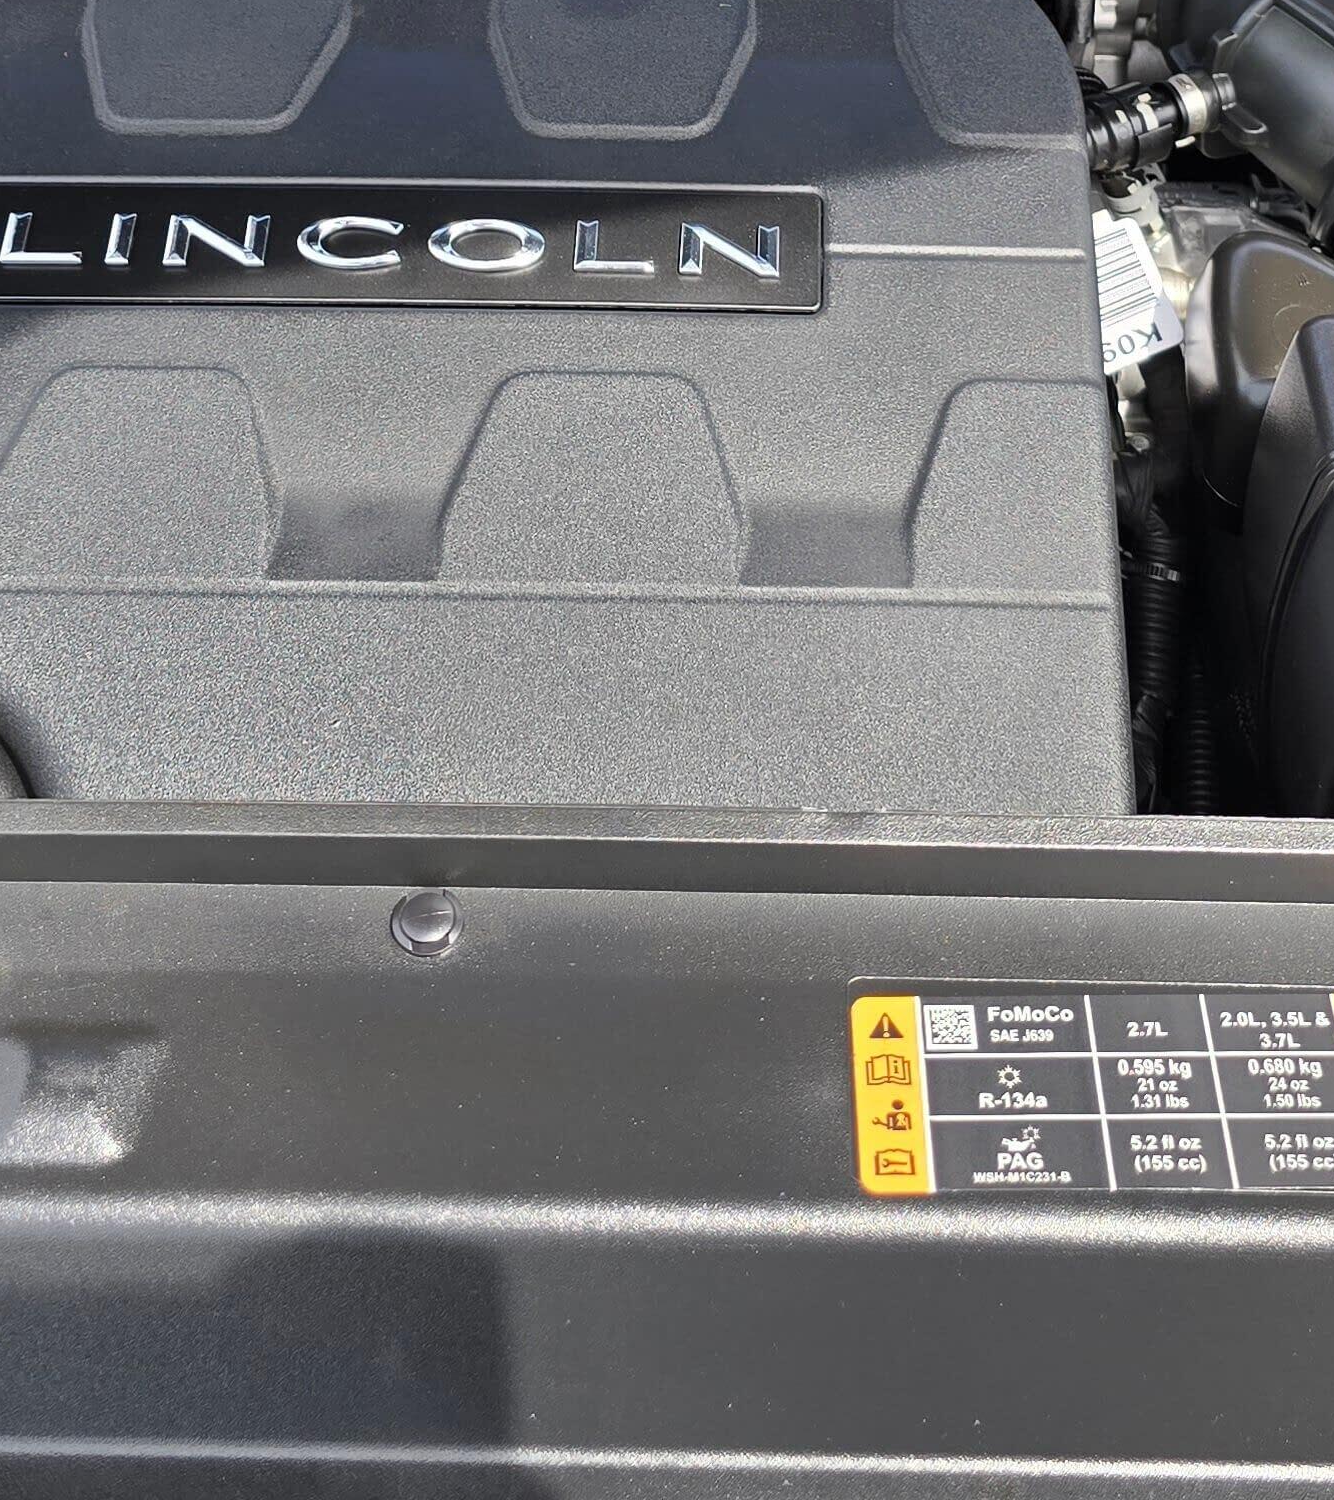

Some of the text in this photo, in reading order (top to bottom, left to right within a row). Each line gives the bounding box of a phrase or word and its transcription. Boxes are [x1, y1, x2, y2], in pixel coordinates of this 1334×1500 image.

[987, 1005, 1074, 1022] FoMoCo
[1220, 1012, 1331, 1028] 2.0L, 3.5L &
[990, 1029, 1054, 1042] SAE J639
[1127, 1021, 1168, 1037] 2.7L
[1259, 1032, 1301, 1048] 3.7L
[1118, 1058, 1192, 1078] 0.595 kg
[1248, 1058, 1323, 1077] 0.680 kg
[1137, 1078, 1179, 1091] 21 oz
[1268, 1077, 1310, 1091] 24 oz
[978, 1092, 1048, 1109] R-134a
[1130, 1094, 1190, 1109] 1.31 lbs
[1263, 1094, 1322, 1109] 1.50 lbs
[1129, 1134, 1202, 1151] 5.2 fl oz
[1264, 1133, 1292, 1150] 5.2
[1295, 1133, 1308, 1150] fl
[997, 1152, 1044, 1170] PAG
[1134, 1154, 1207, 1174] (155 cc)
[1269, 1154, 1310, 1174] (155
